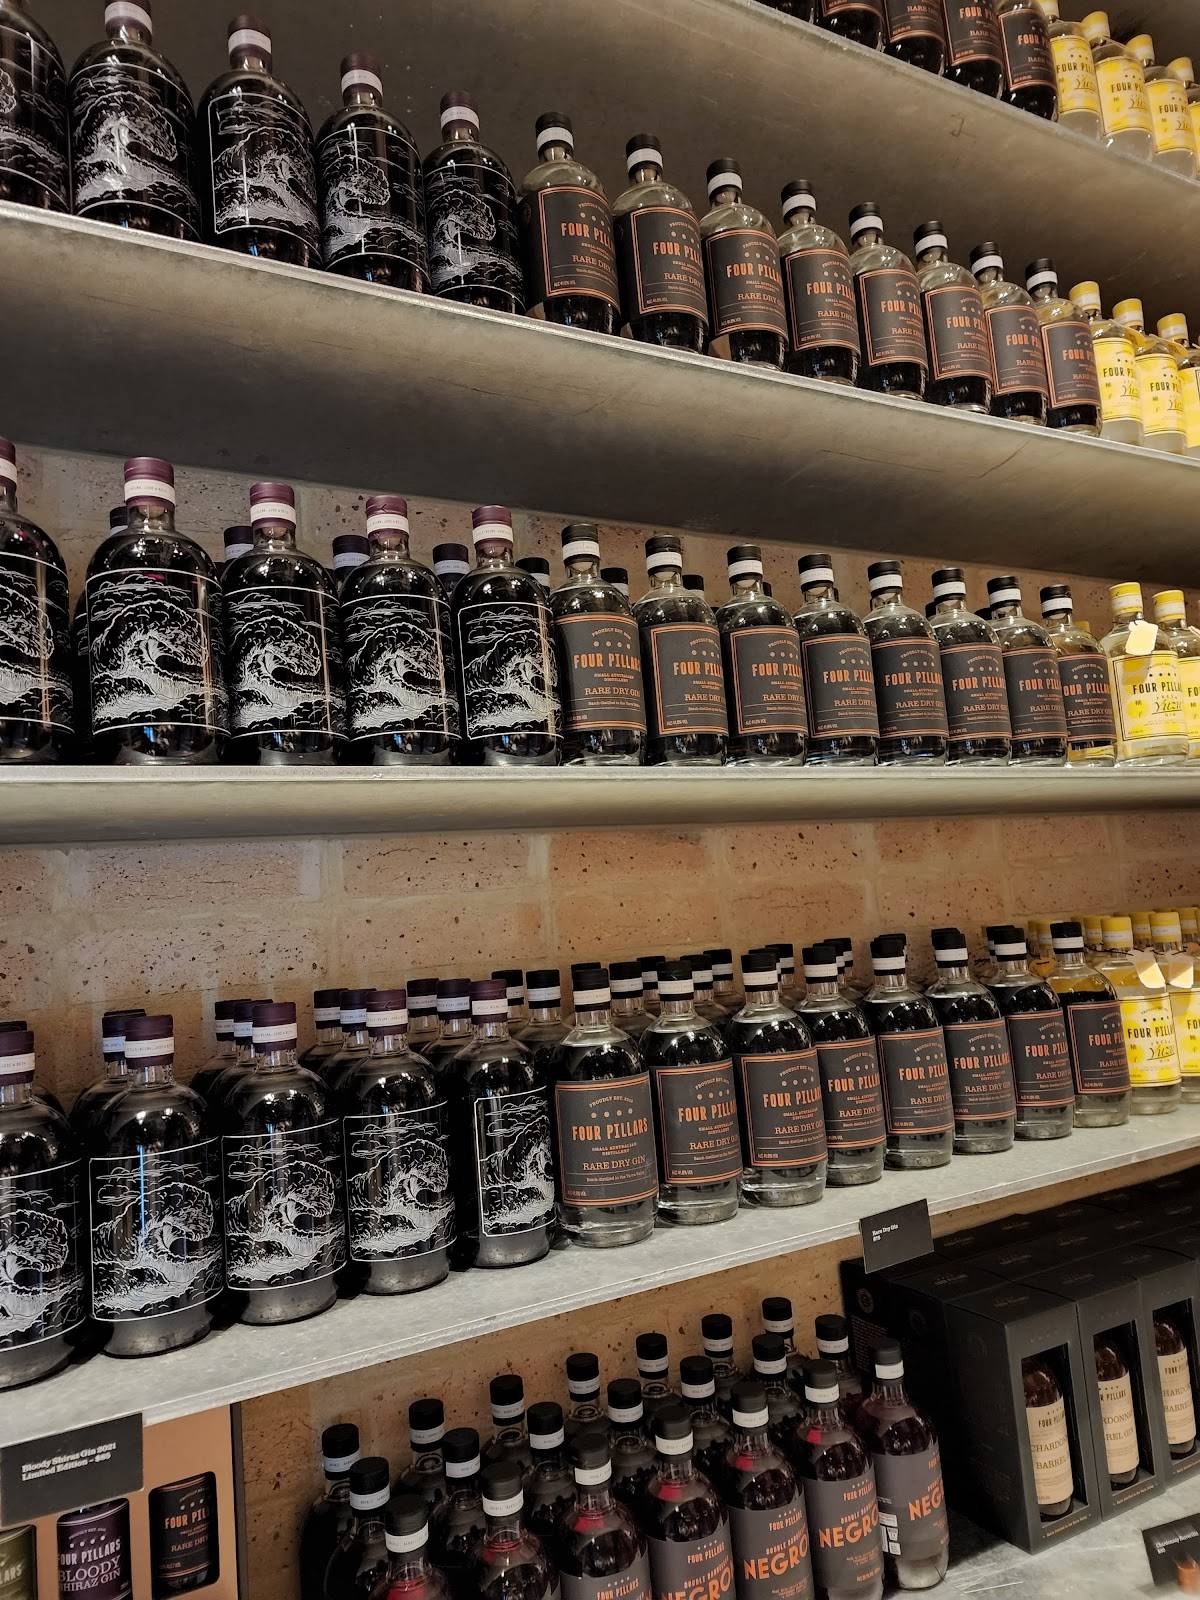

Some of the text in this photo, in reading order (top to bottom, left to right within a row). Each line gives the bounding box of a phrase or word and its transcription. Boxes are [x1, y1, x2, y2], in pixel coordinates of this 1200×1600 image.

[1017, 34, 1040, 46] FOUR
[1056, 62, 1078, 73] FOUR
[1111, 81, 1132, 93] FOUR
[1159, 104, 1178, 114] FOUR
[561, 222, 590, 238] FOUR
[653, 241, 681, 256] FOUR
[572, 254, 612, 272] RARE DRY
[726, 262, 754, 278] FOUR
[663, 272, 687, 282] RARE
[806, 281, 833, 296] FOUR
[737, 292, 762, 301] RARE
[880, 299, 906, 313] FOUR
[817, 310, 840, 318] RARE
[946, 315, 971, 329] FOUR
[891, 327, 913, 335] RARE
[1005, 333, 1029, 346] FOUR
[1062, 348, 1085, 361] FOUR
[1103, 366, 1125, 378] FOUR
[1150, 381, 1170, 393] FOUR
[573, 652, 603, 669] FOUR
[673, 662, 701, 676] FOUR
[752, 663, 779, 677] FOUR
[823, 669, 850, 684] FOUR
[885, 672, 912, 687] FOUR
[952, 677, 978, 691] FOUR
[1018, 678, 1043, 692] FOUR
[1063, 683, 1083, 697] OUR
[1132, 682, 1157, 695] FOUR
[584, 687, 630, 696] RARE DRY
[685, 693, 708, 702] RARE
[834, 699, 857, 707] RARE
[896, 700, 919, 709] RARE
[963, 704, 986, 713] RARE
[1030, 705, 1050, 713] RARE
[1127, 1027, 1152, 1039] FOUR
[1088, 1034, 1112, 1046] FOUR
[1025, 1045, 1049, 1058] FOUR
[954, 1057, 979, 1069] FOUR
[899, 1067, 926, 1081] FOUR
[1036, 1072, 1057, 1080] RARE
[828, 1077, 855, 1093] FOUR
[965, 1083, 1003, 1093] RARE DRY
[763, 1093, 792, 1108] FOUR
[910, 1097, 933, 1105] RARE
[678, 1106, 707, 1123] FOUR
[839, 1107, 876, 1118] RARE DRY
[572, 1117, 648, 1141] FOUR PILLARS
[774, 1123, 815, 1135] RARE DRY
[689, 1137, 732, 1150] RARE DRY
[583, 1154, 646, 1170] RARE DRY GIN
[1106, 1389, 1126, 1400] PILLARS
[22, 1460, 52, 1473] Bloody
[52, 1453, 81, 1465] Shiraz
[80, 1448, 96, 1458] Gin
[22, 1459, 88, 1481] Limited Edition
[165, 1513, 188, 1530] FOUR
[768, 1520, 784, 1532] FOUR
[60, 1538, 121, 1566] OUR PILLARS
[687, 1542, 725, 1565] FOUR PILLARS
[100, 1568, 121, 1584] GIN
[684, 1574, 706, 1589] DOUBLE
[615, 1578, 639, 1597] PILLARS
